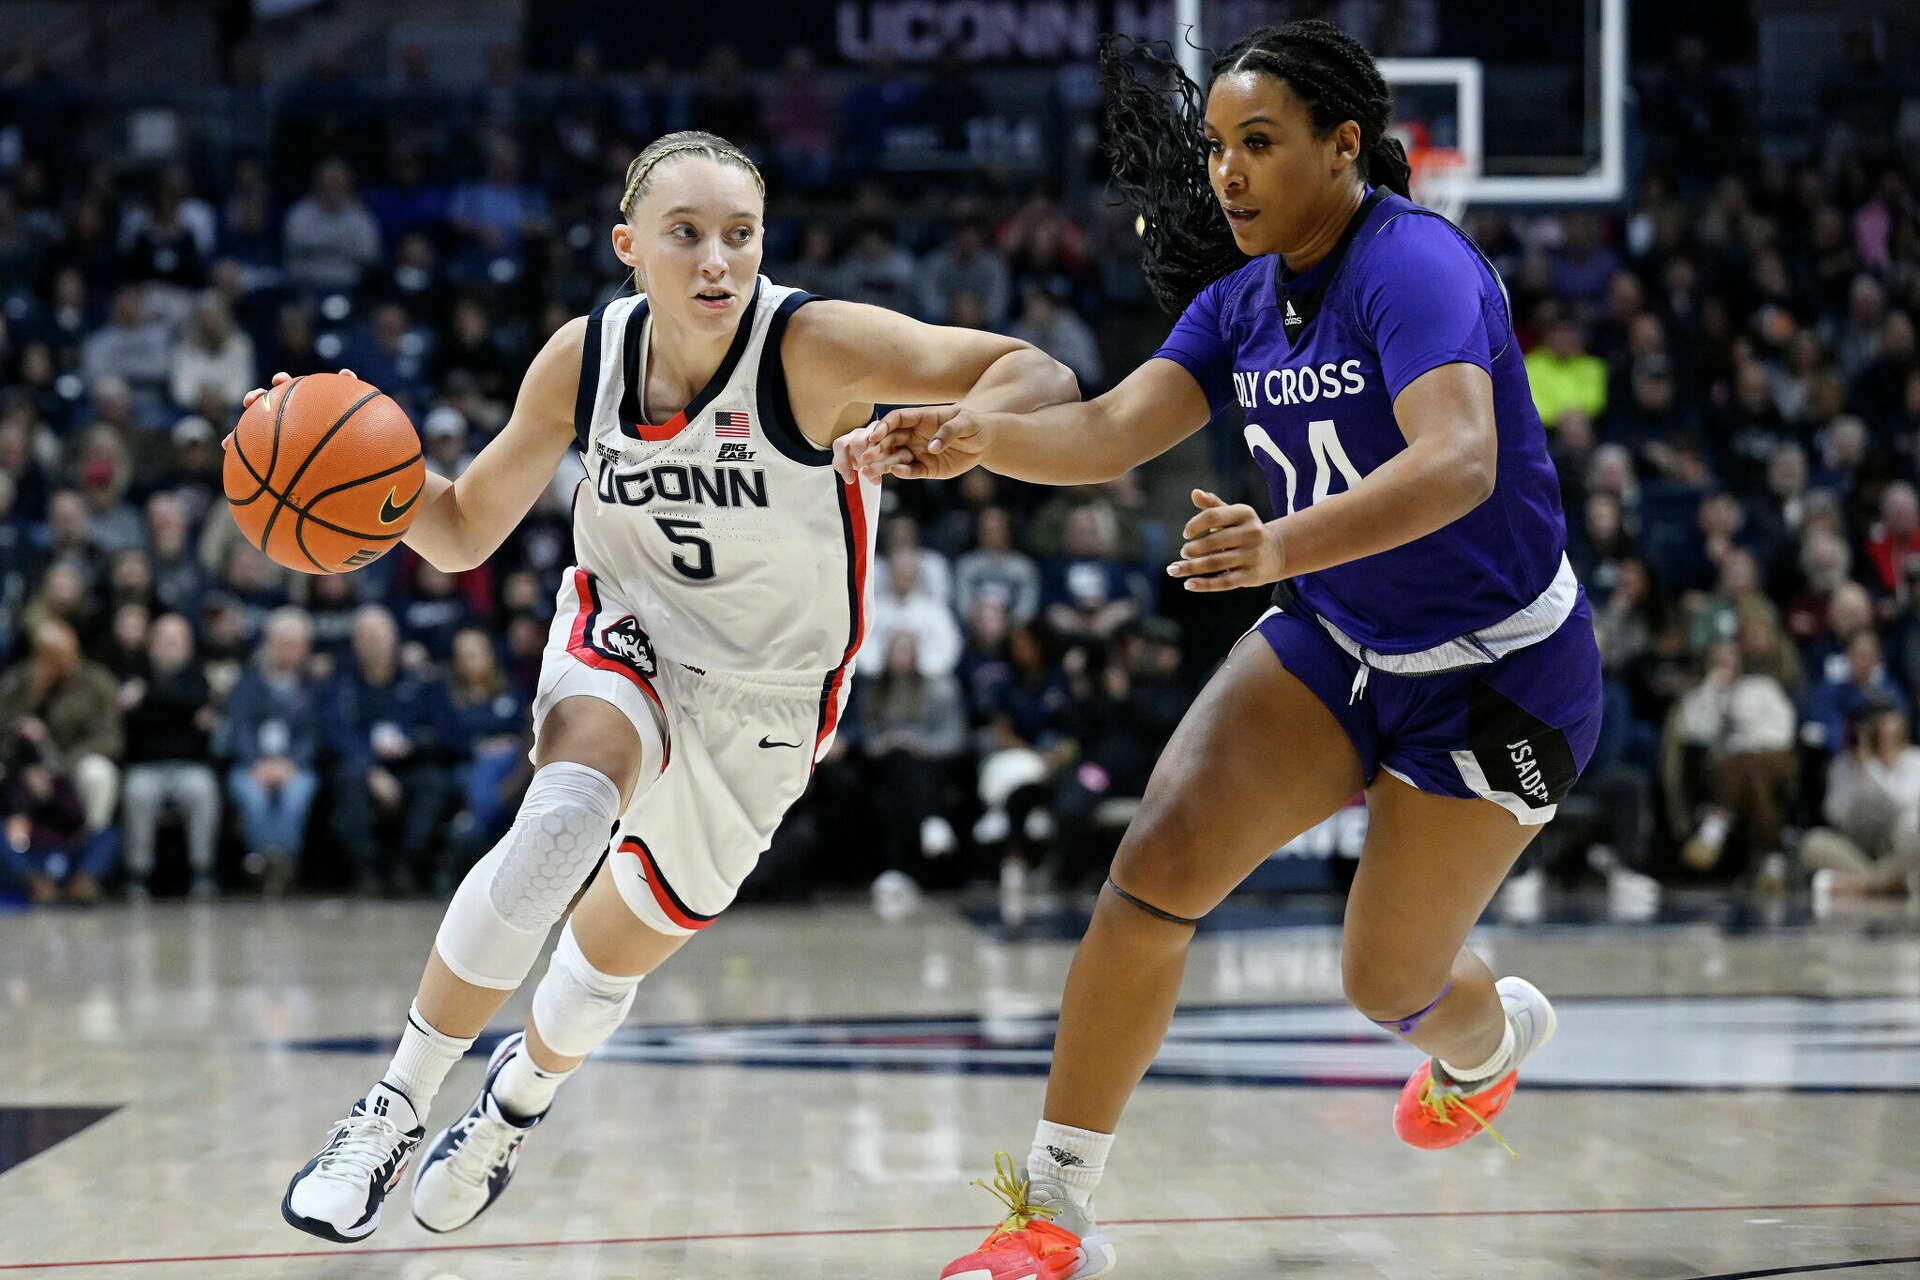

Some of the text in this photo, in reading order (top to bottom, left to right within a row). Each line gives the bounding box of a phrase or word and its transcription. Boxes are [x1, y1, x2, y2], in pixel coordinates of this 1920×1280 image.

[836, 1, 1097, 60] UCONN
[1264, 359, 1366, 406] CROSS
[717, 450, 757, 460] EAST
[720, 442, 748, 452] BIG
[598, 459, 769, 508] UCONN
[654, 515, 717, 579] 5
